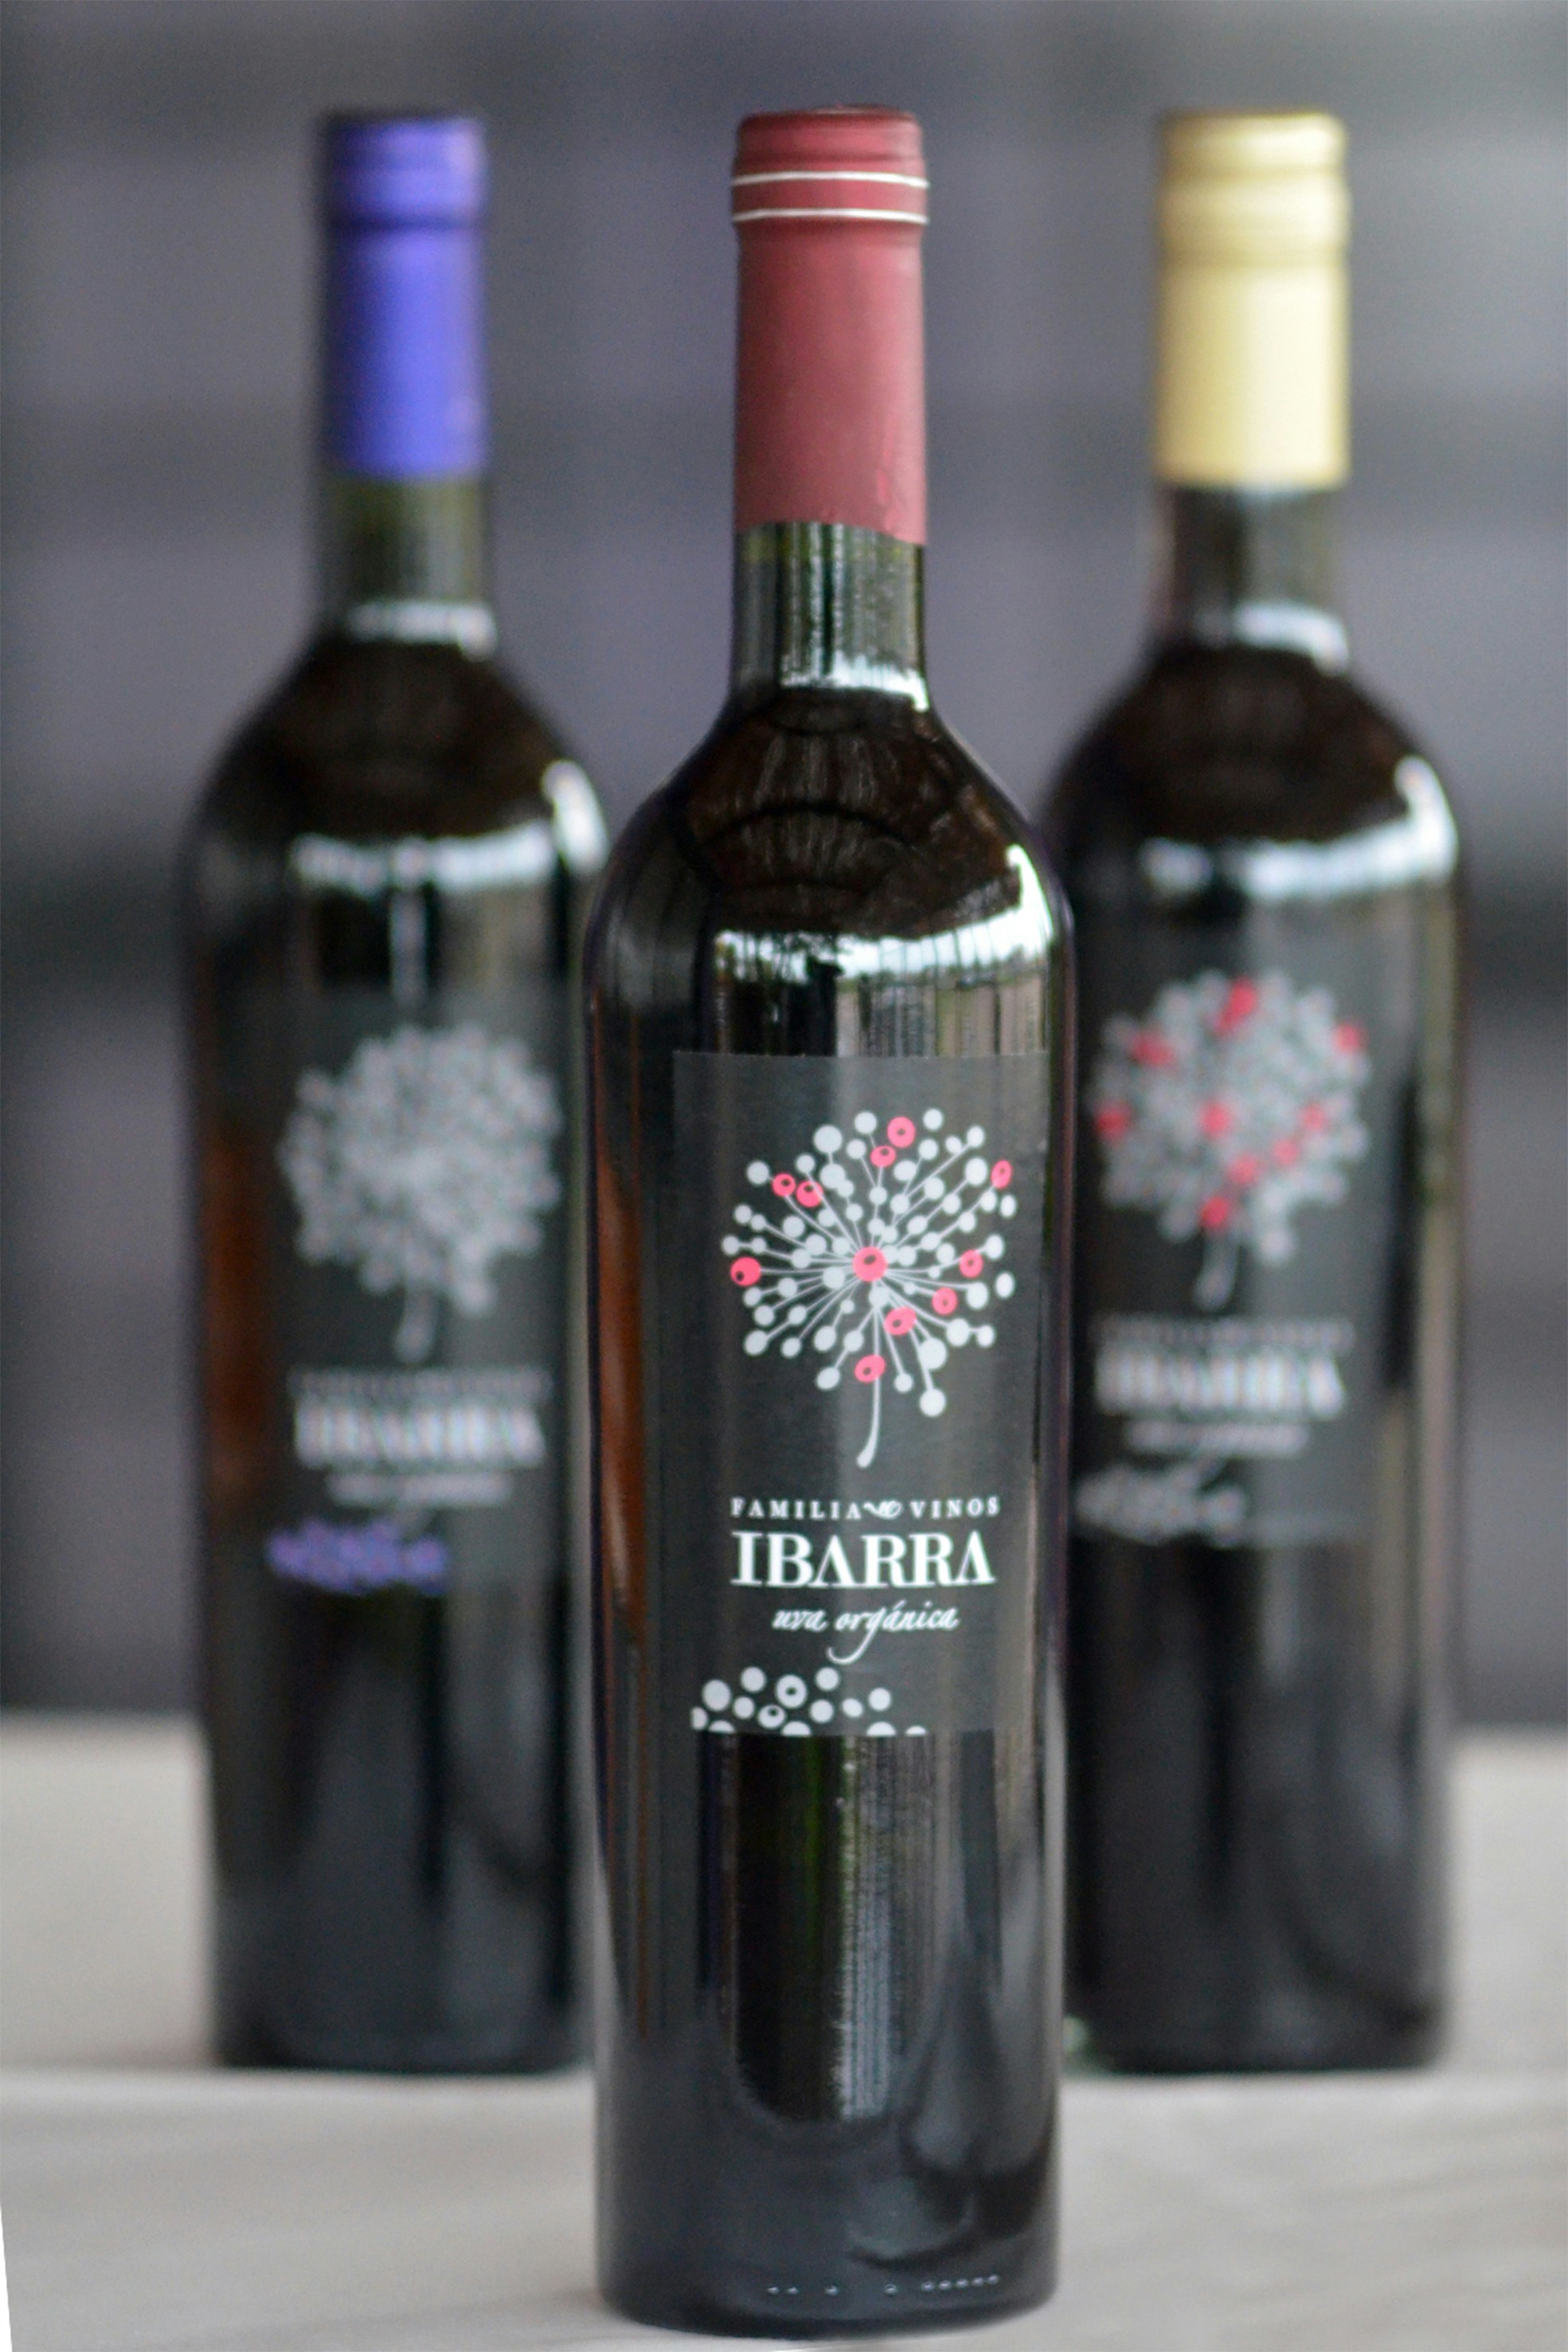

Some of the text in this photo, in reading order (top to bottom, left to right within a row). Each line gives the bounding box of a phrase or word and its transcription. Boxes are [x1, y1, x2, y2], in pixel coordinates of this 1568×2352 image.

[730, 1496, 1001, 1520] FAMILIA VINOS
[730, 1530, 996, 1588] IBARRA
[772, 1599, 960, 1665] uva orgánica
